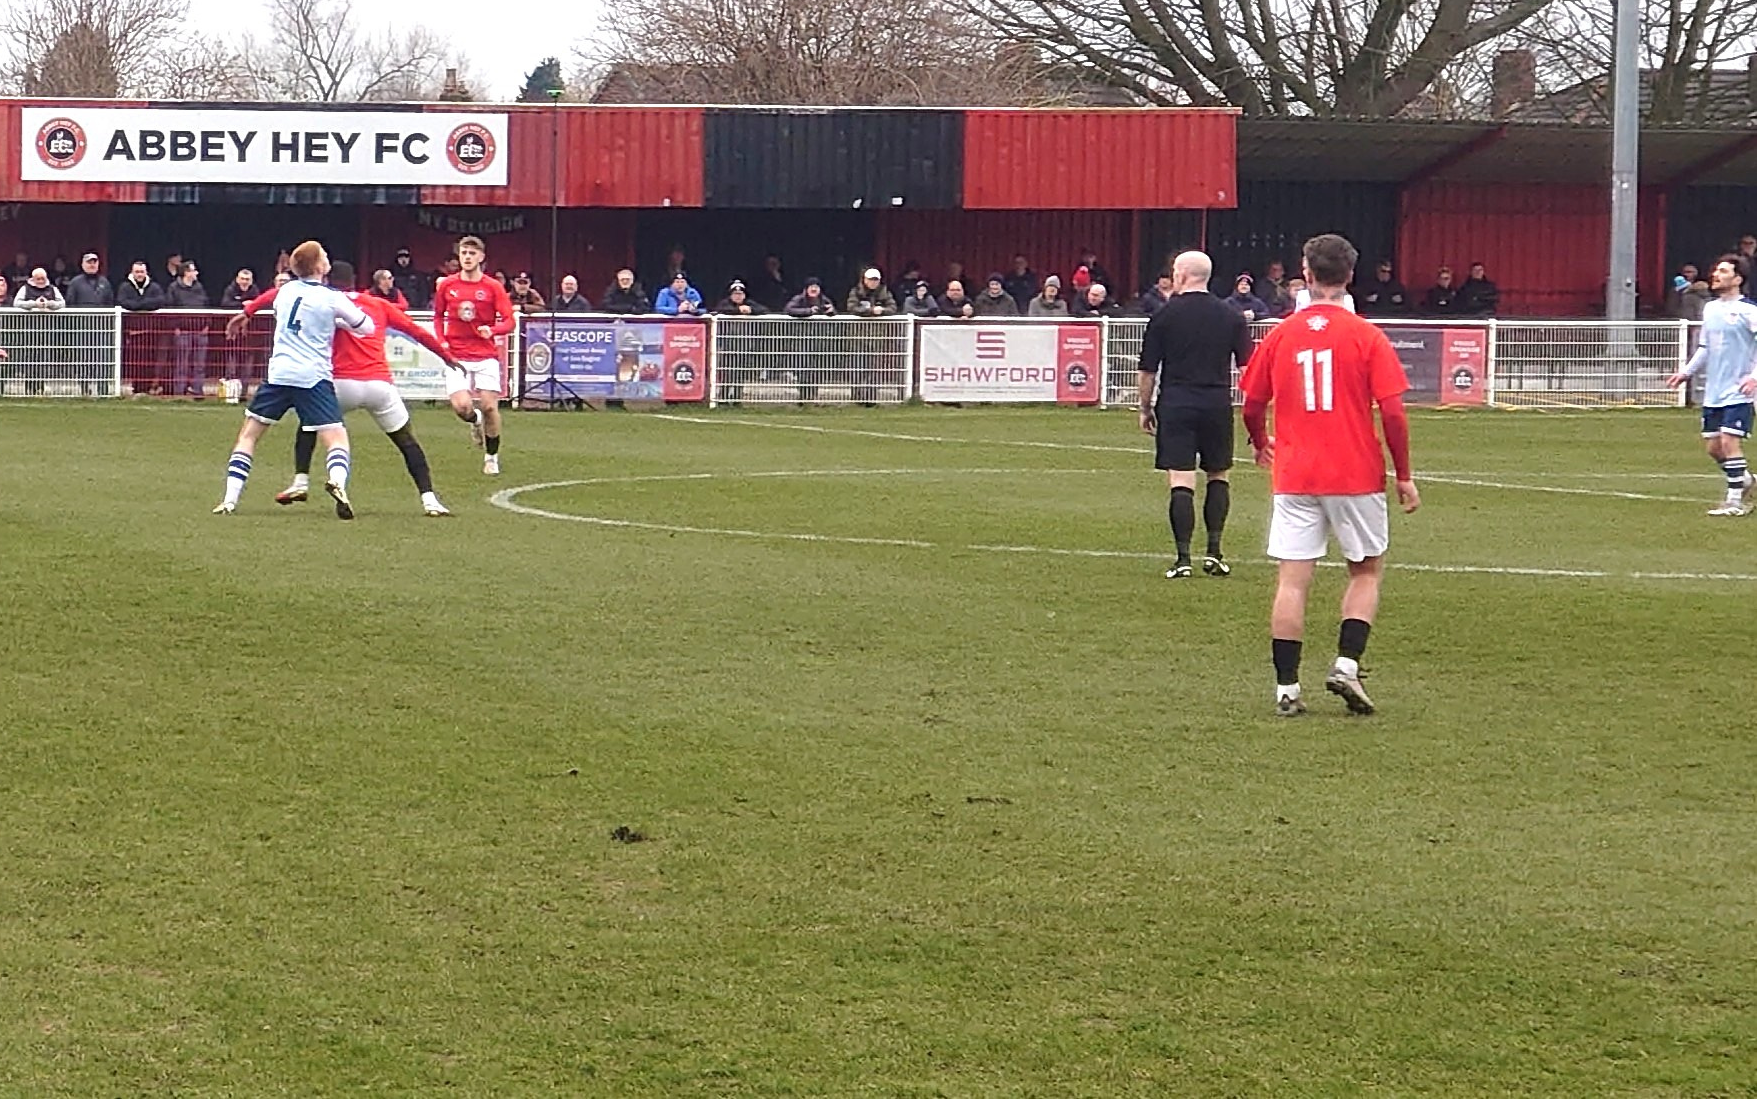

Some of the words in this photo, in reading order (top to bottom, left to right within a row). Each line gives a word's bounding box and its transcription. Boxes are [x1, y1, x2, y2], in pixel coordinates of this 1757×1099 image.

[102, 130, 258, 162] ABBEY
[271, 131, 361, 164] HEY
[374, 132, 430, 165] FC
[287, 296, 303, 336] 4
[546, 330, 613, 343] SEASCOPE
[925, 367, 1056, 383] SHAWFORD
[1297, 349, 1333, 412] 11
